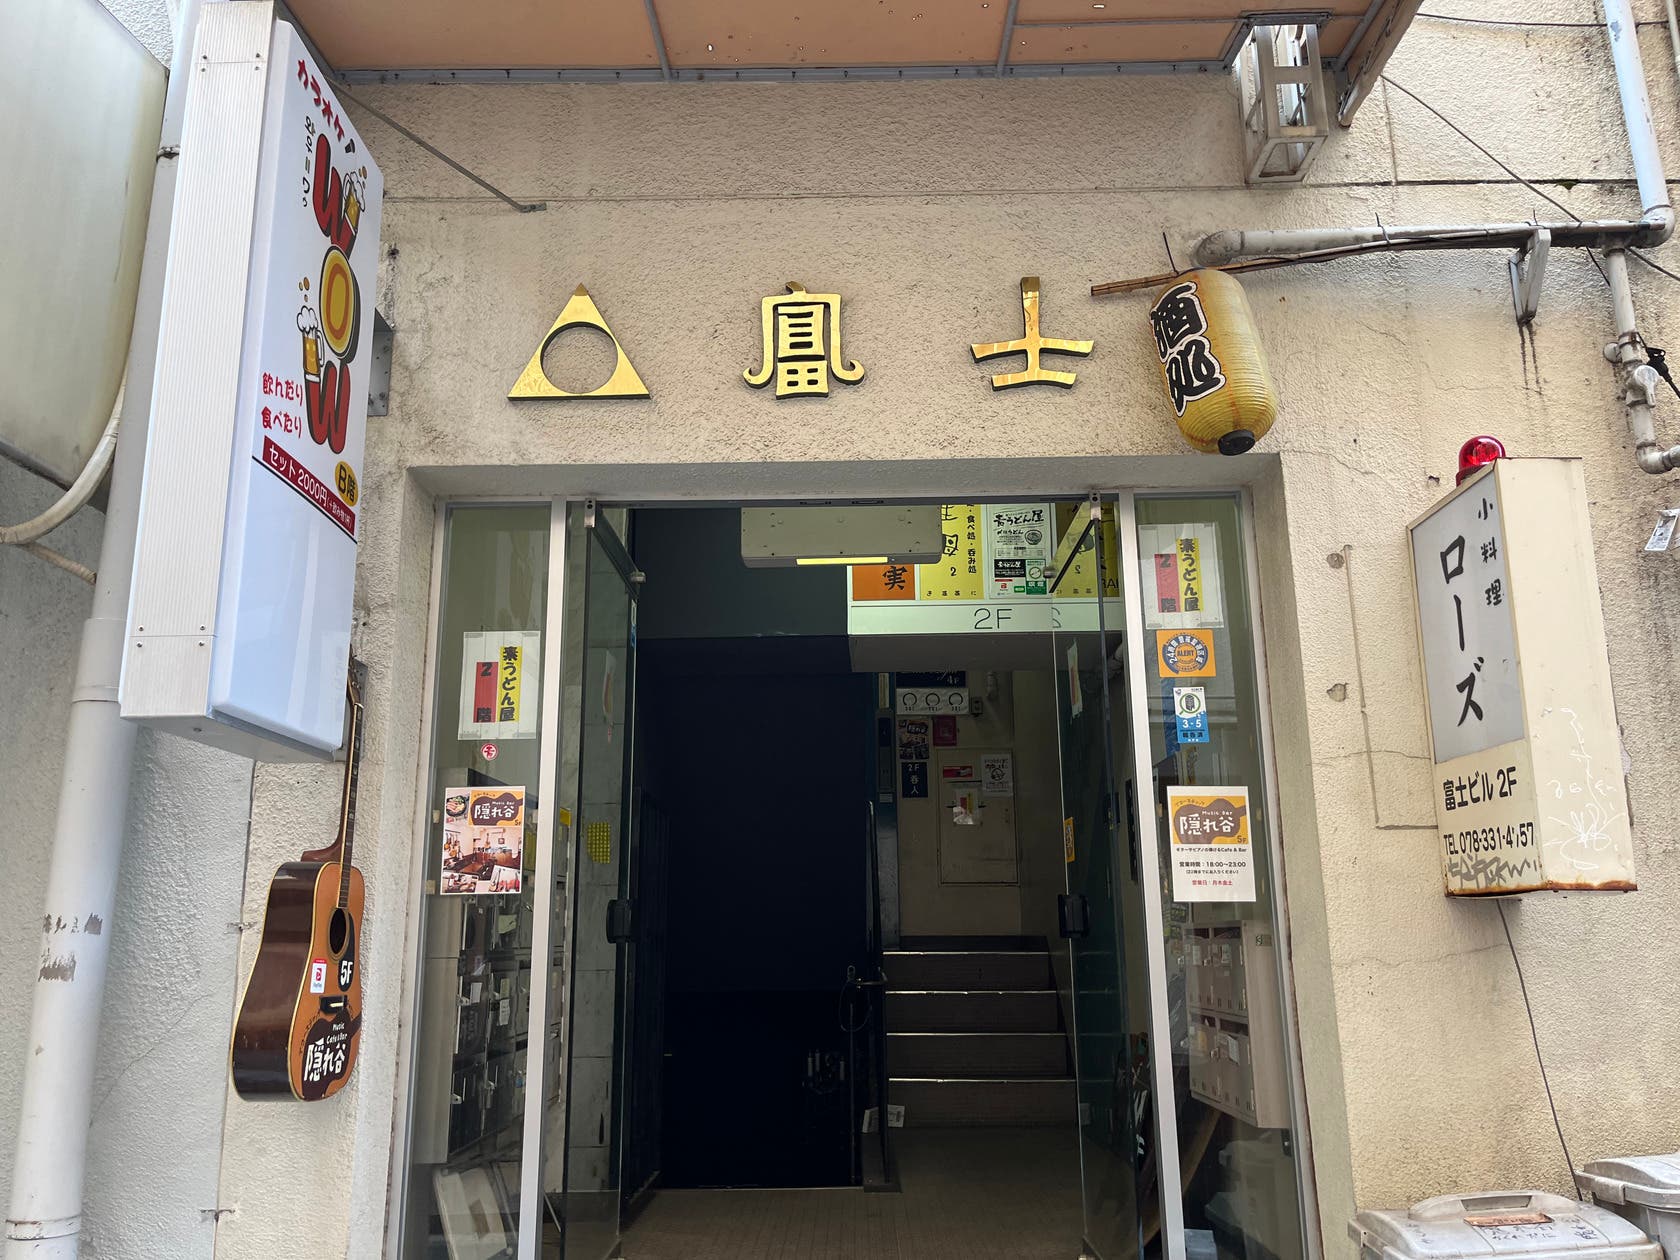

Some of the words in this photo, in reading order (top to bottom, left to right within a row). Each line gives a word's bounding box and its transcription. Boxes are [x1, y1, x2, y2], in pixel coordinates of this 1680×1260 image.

[297, 59, 344, 142] カラオケ
[262, 372, 303, 406] 飲んだり
[261, 406, 302, 438] 食べたり
[269, 446, 296, 478] セット
[298, 469, 328, 508] 2000円
[1478, 498, 1503, 607] 小料理
[882, 566, 908, 591] 実
[950, 567, 957, 576] 2
[974, 608, 1012, 629] 2F
[1440, 534, 1484, 728] ローズ
[1443, 770, 1494, 811] 富士ビル
[1497, 766, 1517, 797] 2F
[474, 803, 515, 821] 隠れ谷
[1180, 813, 1235, 836] 隠れ谷
[1443, 834, 1459, 855] TEL
[341, 960, 353, 985] 5F
[304, 1037, 345, 1082] 隠れ谷
